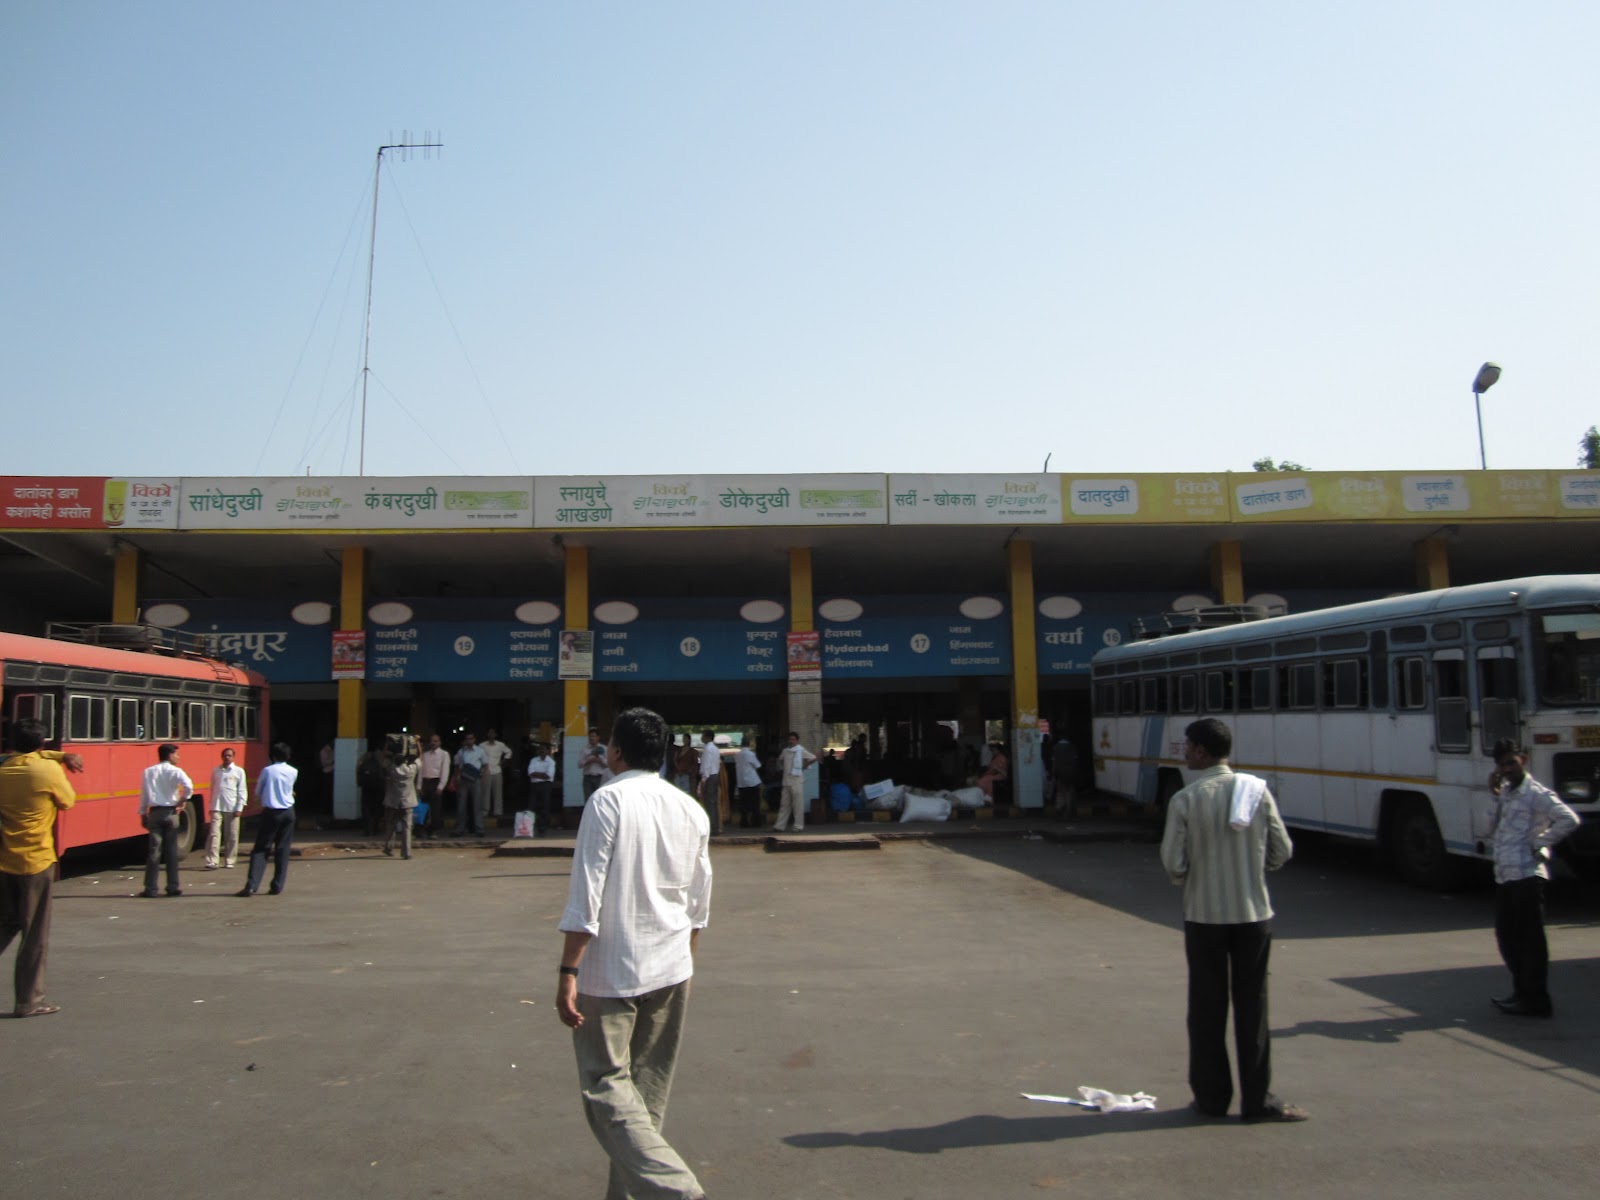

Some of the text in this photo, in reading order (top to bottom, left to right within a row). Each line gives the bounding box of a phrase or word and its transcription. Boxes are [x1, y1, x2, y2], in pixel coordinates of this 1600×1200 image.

[13, 485, 79, 499] दातांवर डाग
[131, 483, 172, 497] विको
[559, 481, 607, 507] स्नायुचे
[894, 489, 917, 506] सर्दी
[933, 489, 976, 506] खोकला
[1078, 485, 1130, 507] दातदुखी
[1242, 488, 1307, 507] दातांवर डाग
[189, 487, 263, 517] सांधेदुखी
[364, 487, 438, 517] कंबरदुखी
[718, 487, 790, 514] डोकेदुखी
[6, 503, 92, 519] कशाचेही असोत
[555, 502, 613, 523] आखडणे
[602, 631, 628, 640] जाम
[914, 638, 927, 649] 17
[1044, 626, 1084, 645] वर्धा
[1105, 632, 1119, 643] 16
[458, 641, 471, 651] 19
[602, 646, 625, 656] वणी
[683, 641, 697, 652] 18
[825, 643, 889, 654] Hyderabad
